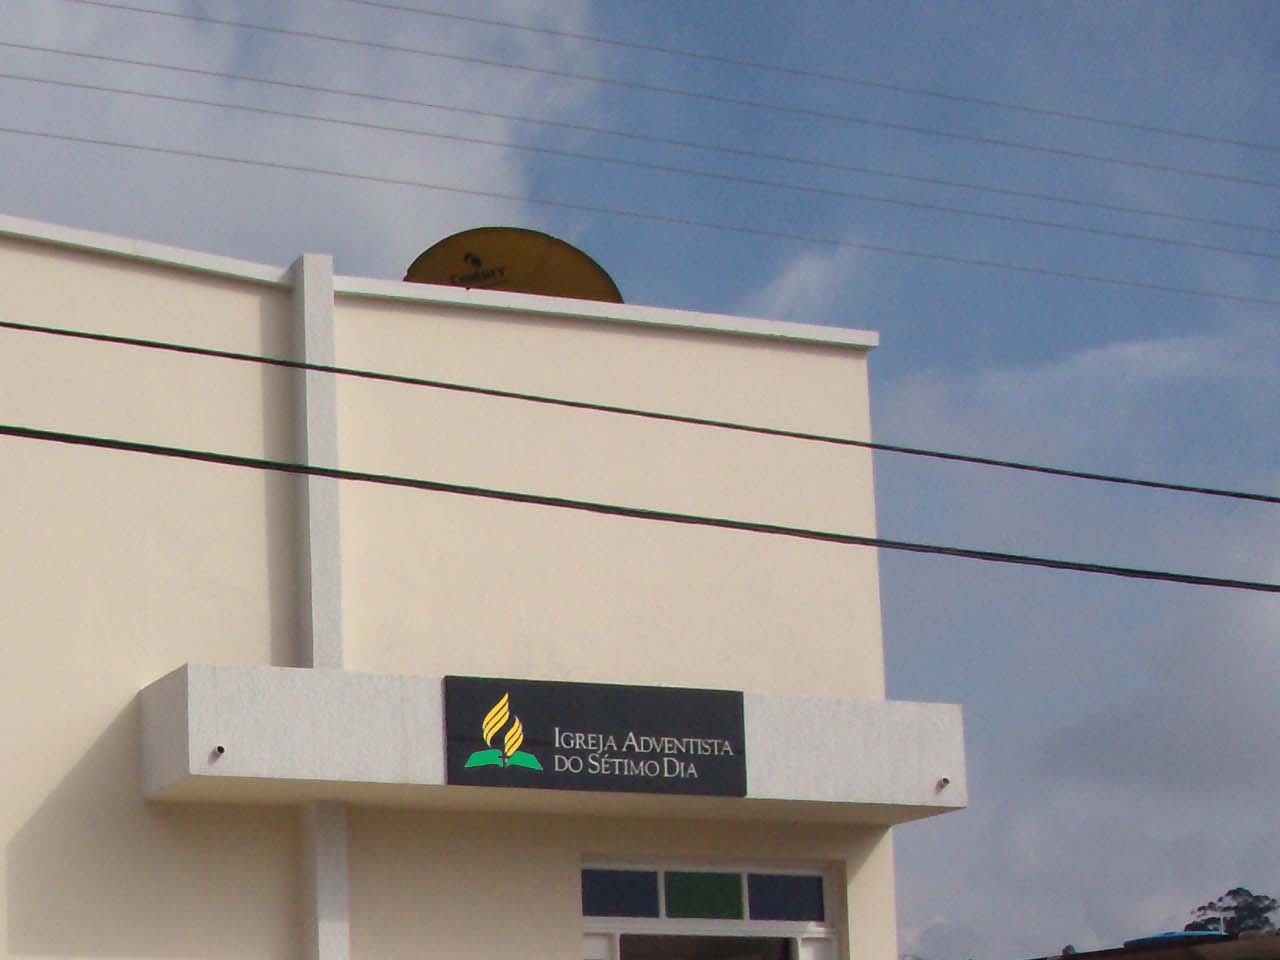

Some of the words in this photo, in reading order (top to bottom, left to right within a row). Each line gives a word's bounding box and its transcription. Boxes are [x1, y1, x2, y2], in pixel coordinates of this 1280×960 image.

[554, 727, 617, 751] IGREJA
[622, 731, 734, 756] ADVENTISTA
[555, 754, 583, 774] DO
[588, 752, 661, 778] SÉTIMO
[663, 757, 699, 778] DIA
